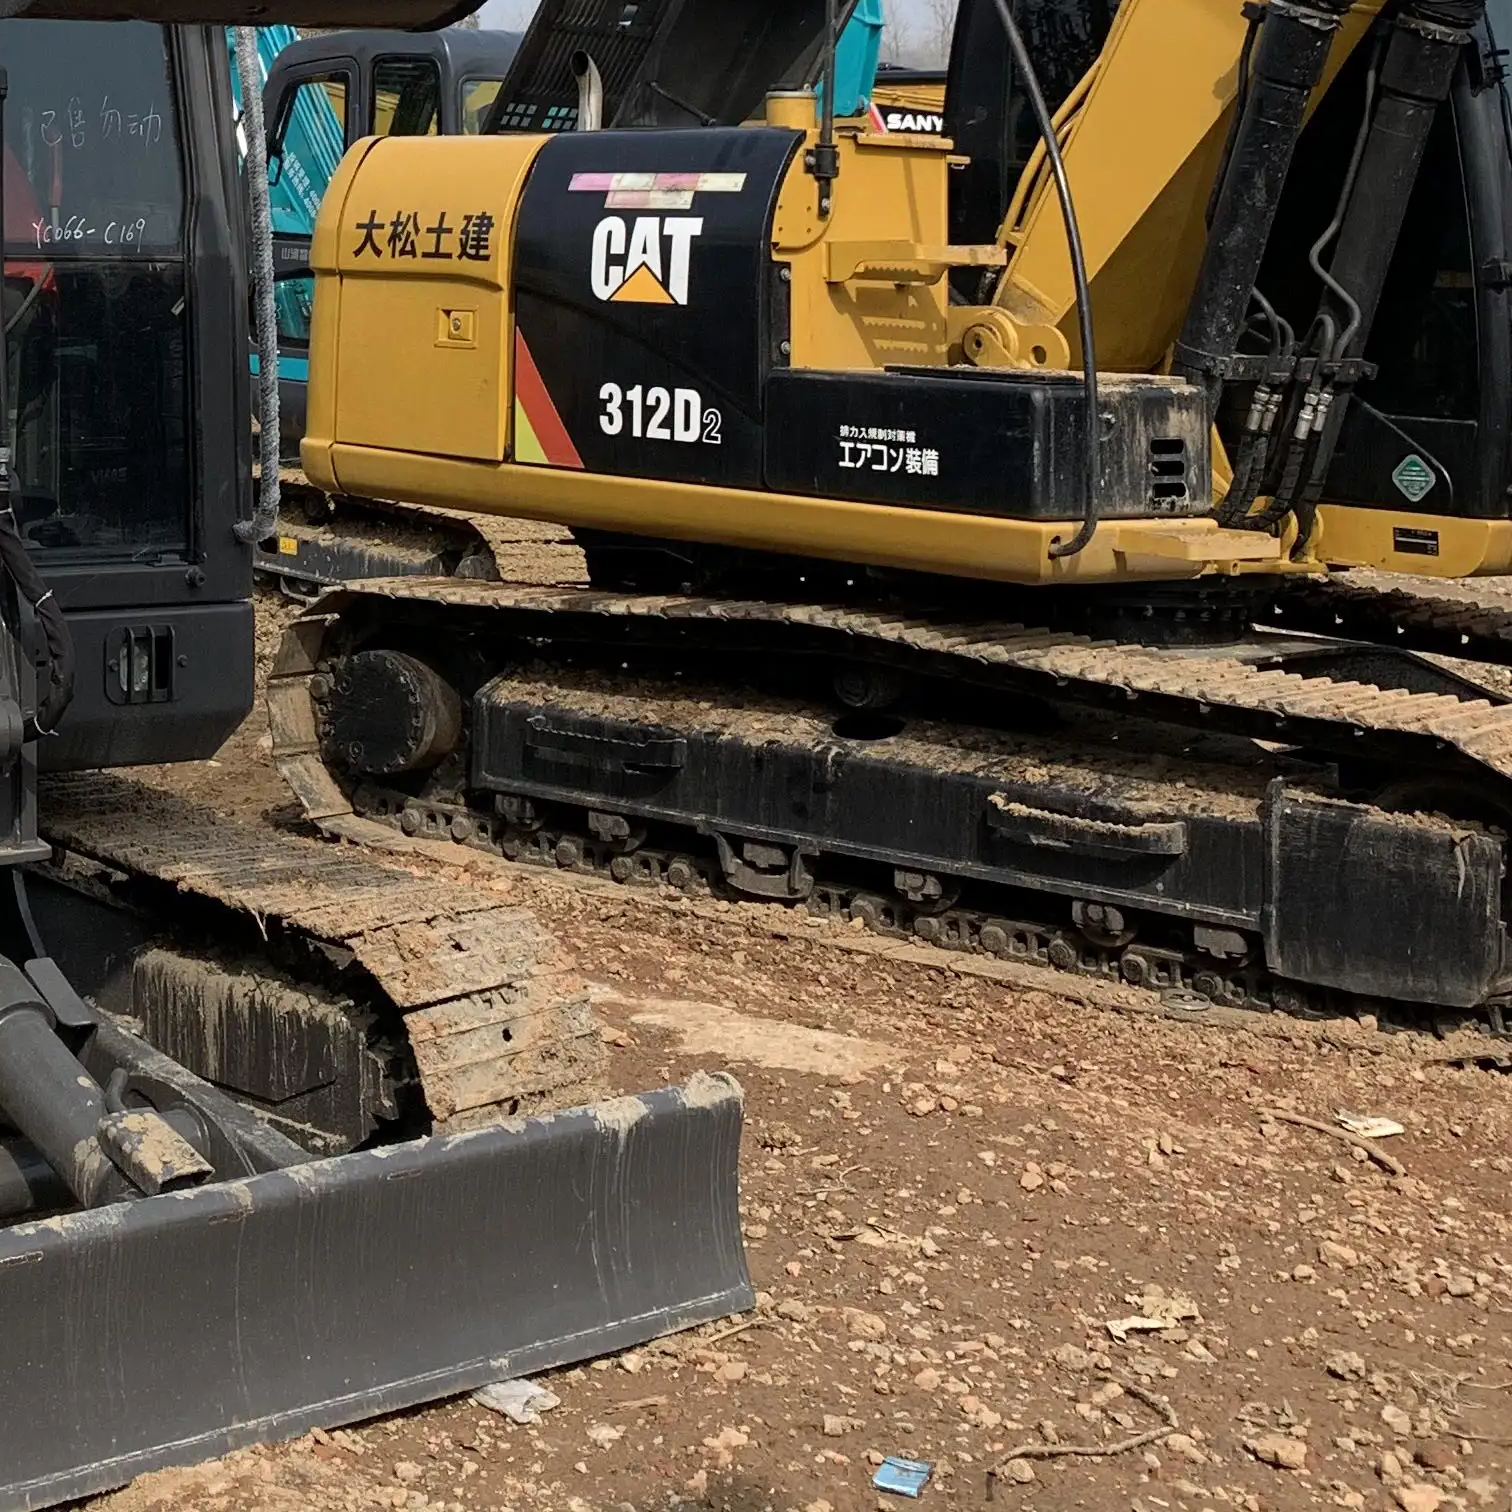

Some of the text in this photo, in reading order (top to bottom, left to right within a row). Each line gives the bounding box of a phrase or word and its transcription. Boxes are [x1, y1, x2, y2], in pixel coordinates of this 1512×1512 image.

[886, 113, 944, 132] SANY
[353, 209, 495, 262] 大松土建
[590, 216, 704, 305] CAT
[838, 441, 940, 476] エアコン装備
